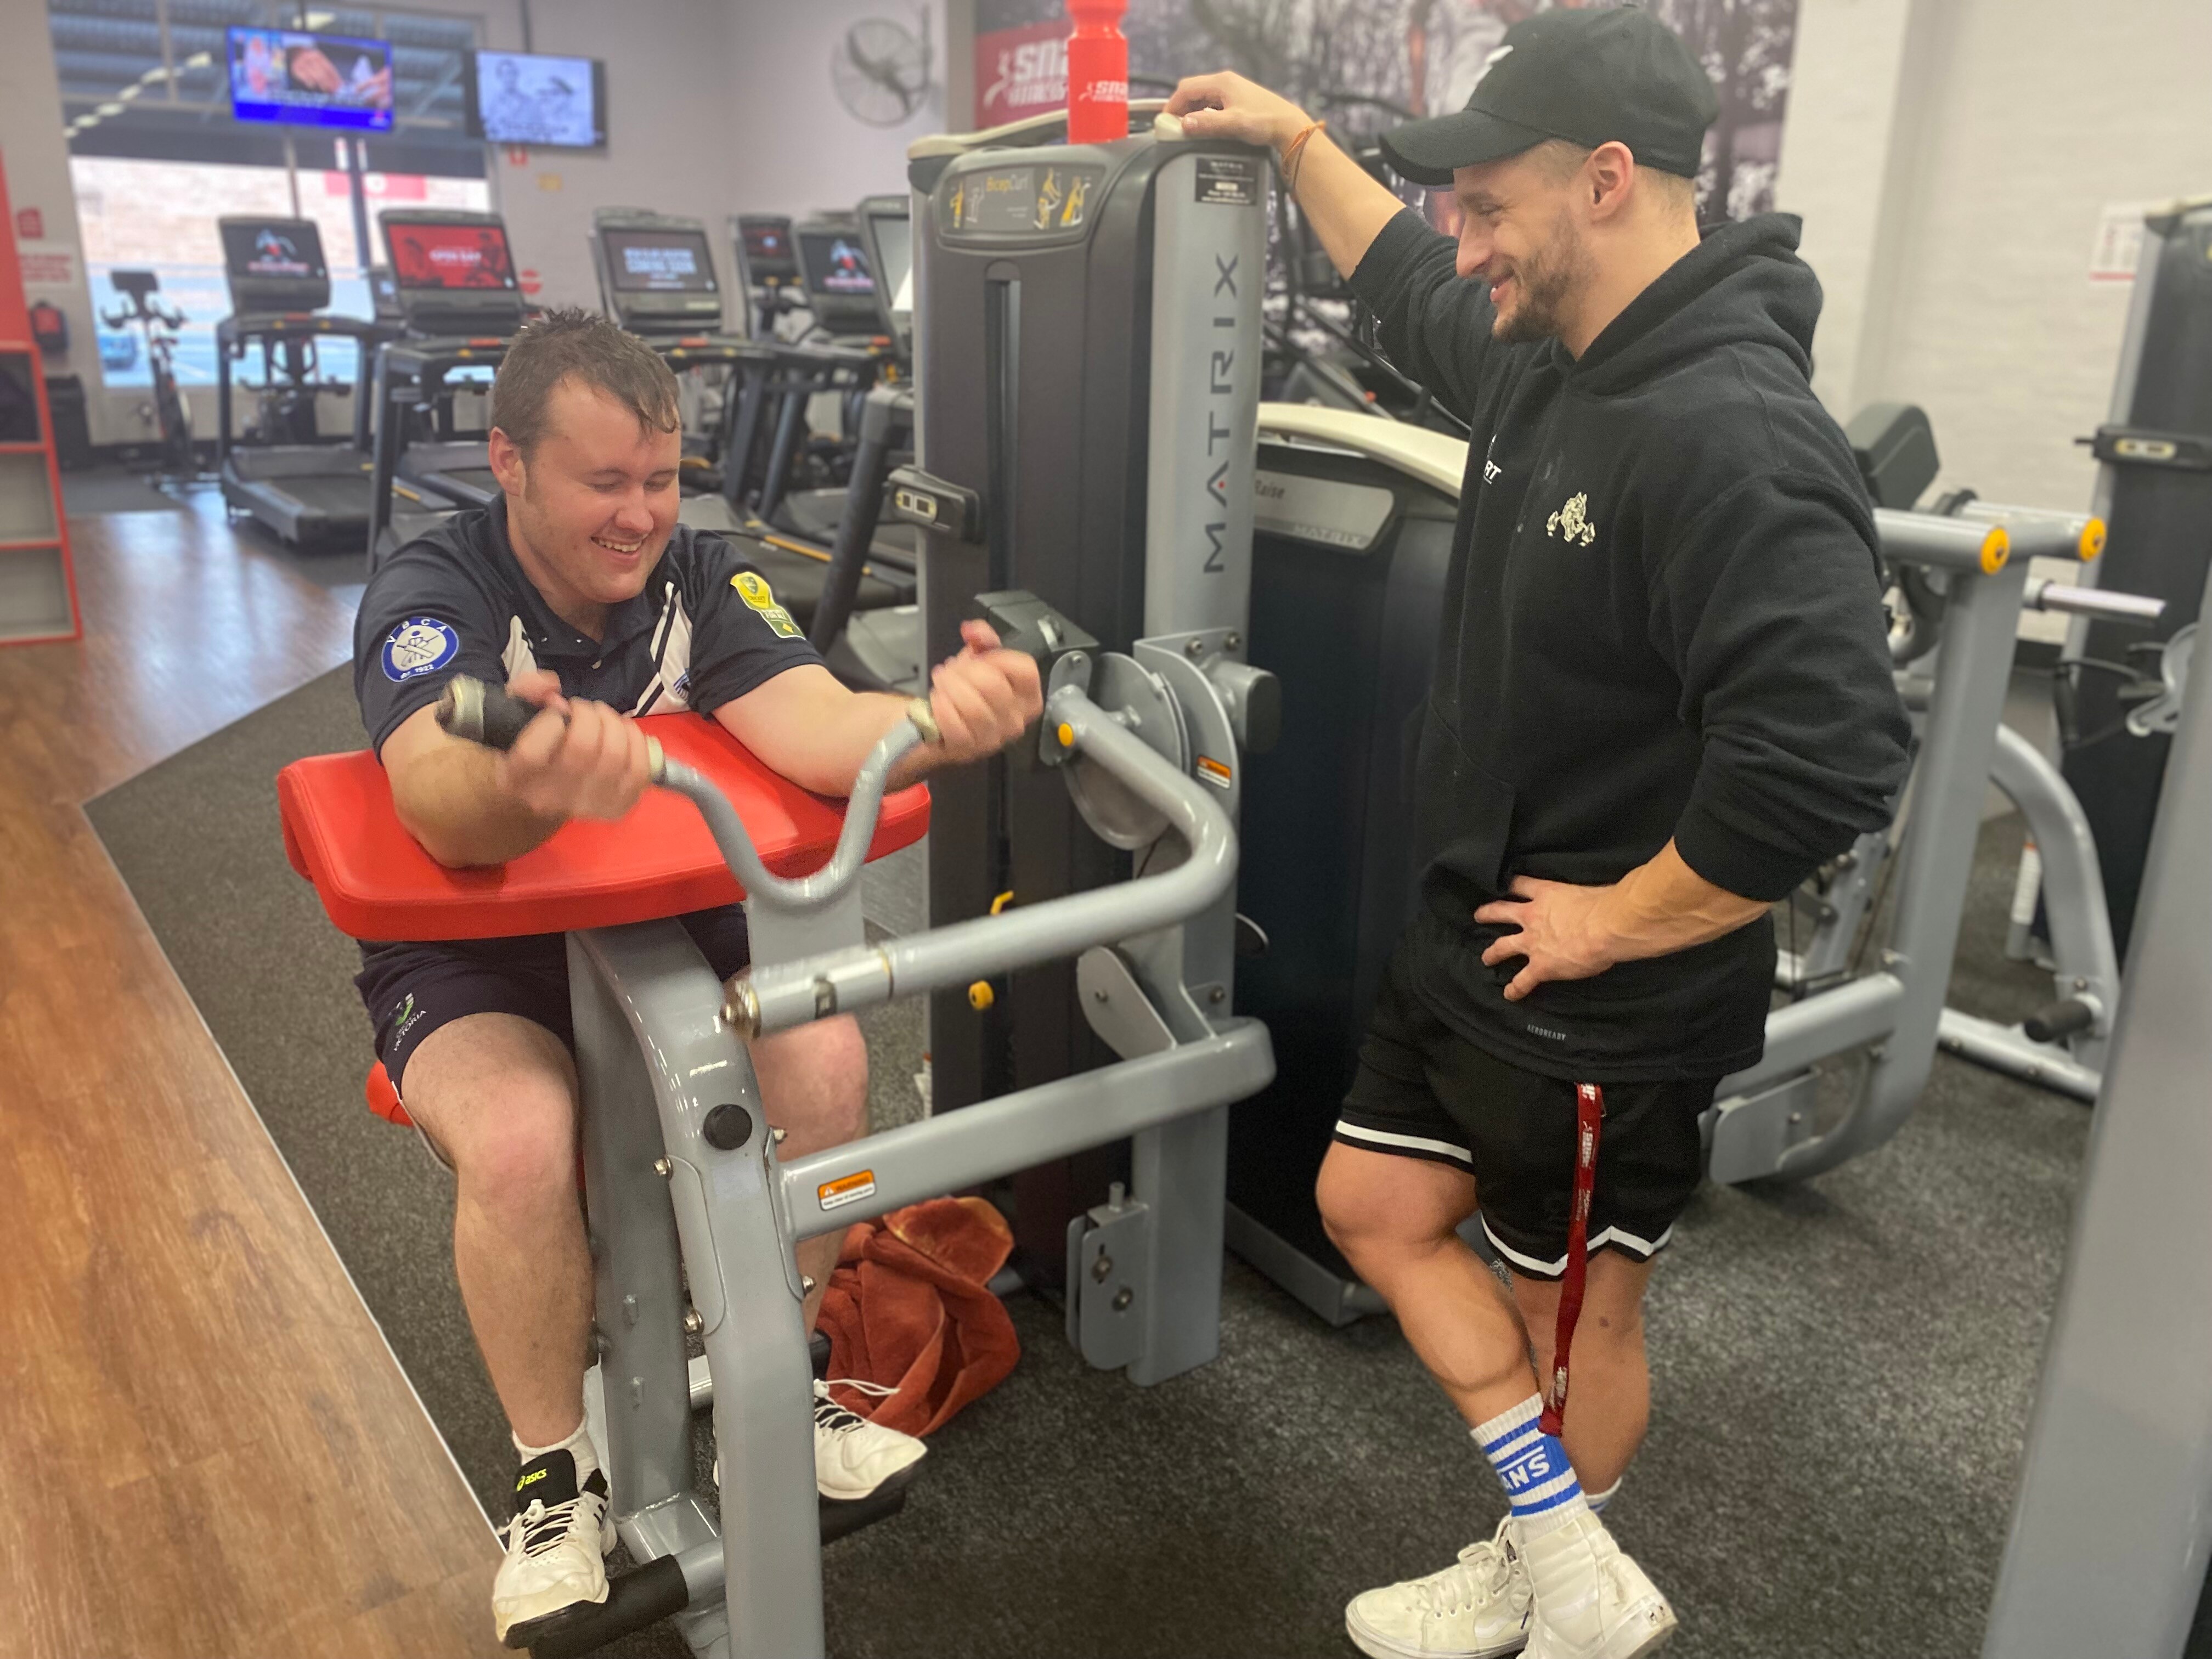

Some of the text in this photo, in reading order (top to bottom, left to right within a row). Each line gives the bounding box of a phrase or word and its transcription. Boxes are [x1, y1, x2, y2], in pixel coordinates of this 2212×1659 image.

[1014, 38, 1069, 82] sn
[1204, 254, 1238, 574] MATRIX
[415, 664, 435, 673] 1922
[525, 1468, 547, 1485] asics
[1500, 1453, 1550, 1490] ANS
